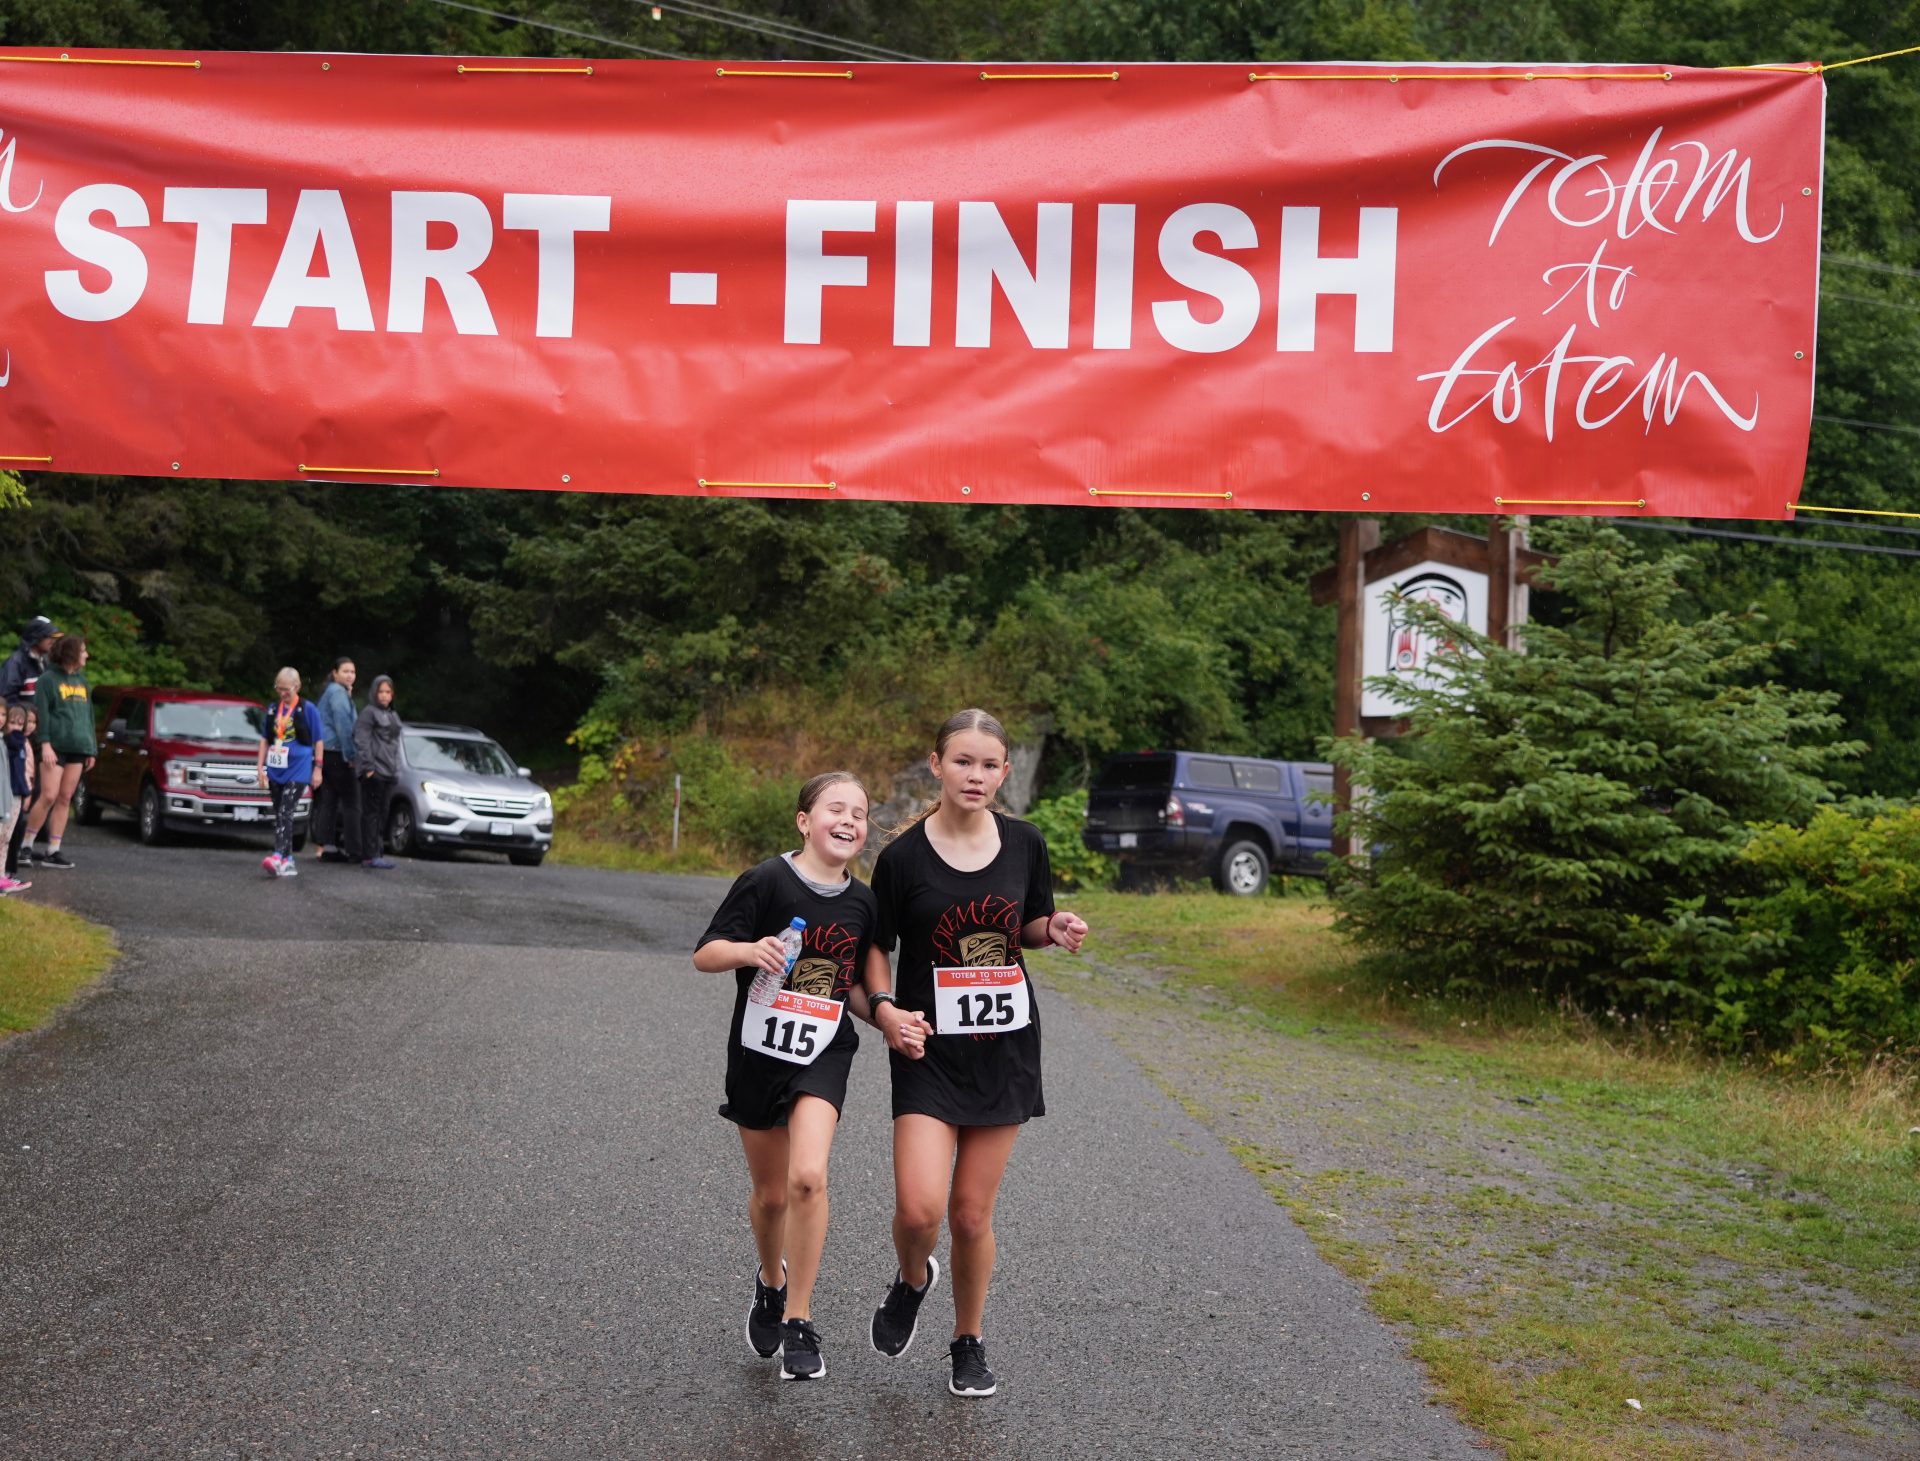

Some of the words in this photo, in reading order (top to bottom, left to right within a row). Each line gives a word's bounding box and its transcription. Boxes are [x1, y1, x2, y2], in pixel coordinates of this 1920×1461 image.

[45, 184, 612, 338] START
[670, 273, 717, 305] -
[784, 193, 1398, 353] FINISH
[1542, 239, 1639, 328] to
[1417, 317, 1758, 443] totem
[993, 970, 1017, 978] TOTEM
[792, 997, 803, 1005] TO
[806, 1000, 831, 1011] TOTEM
[957, 993, 1015, 1026] 125
[761, 1016, 818, 1058] 115
